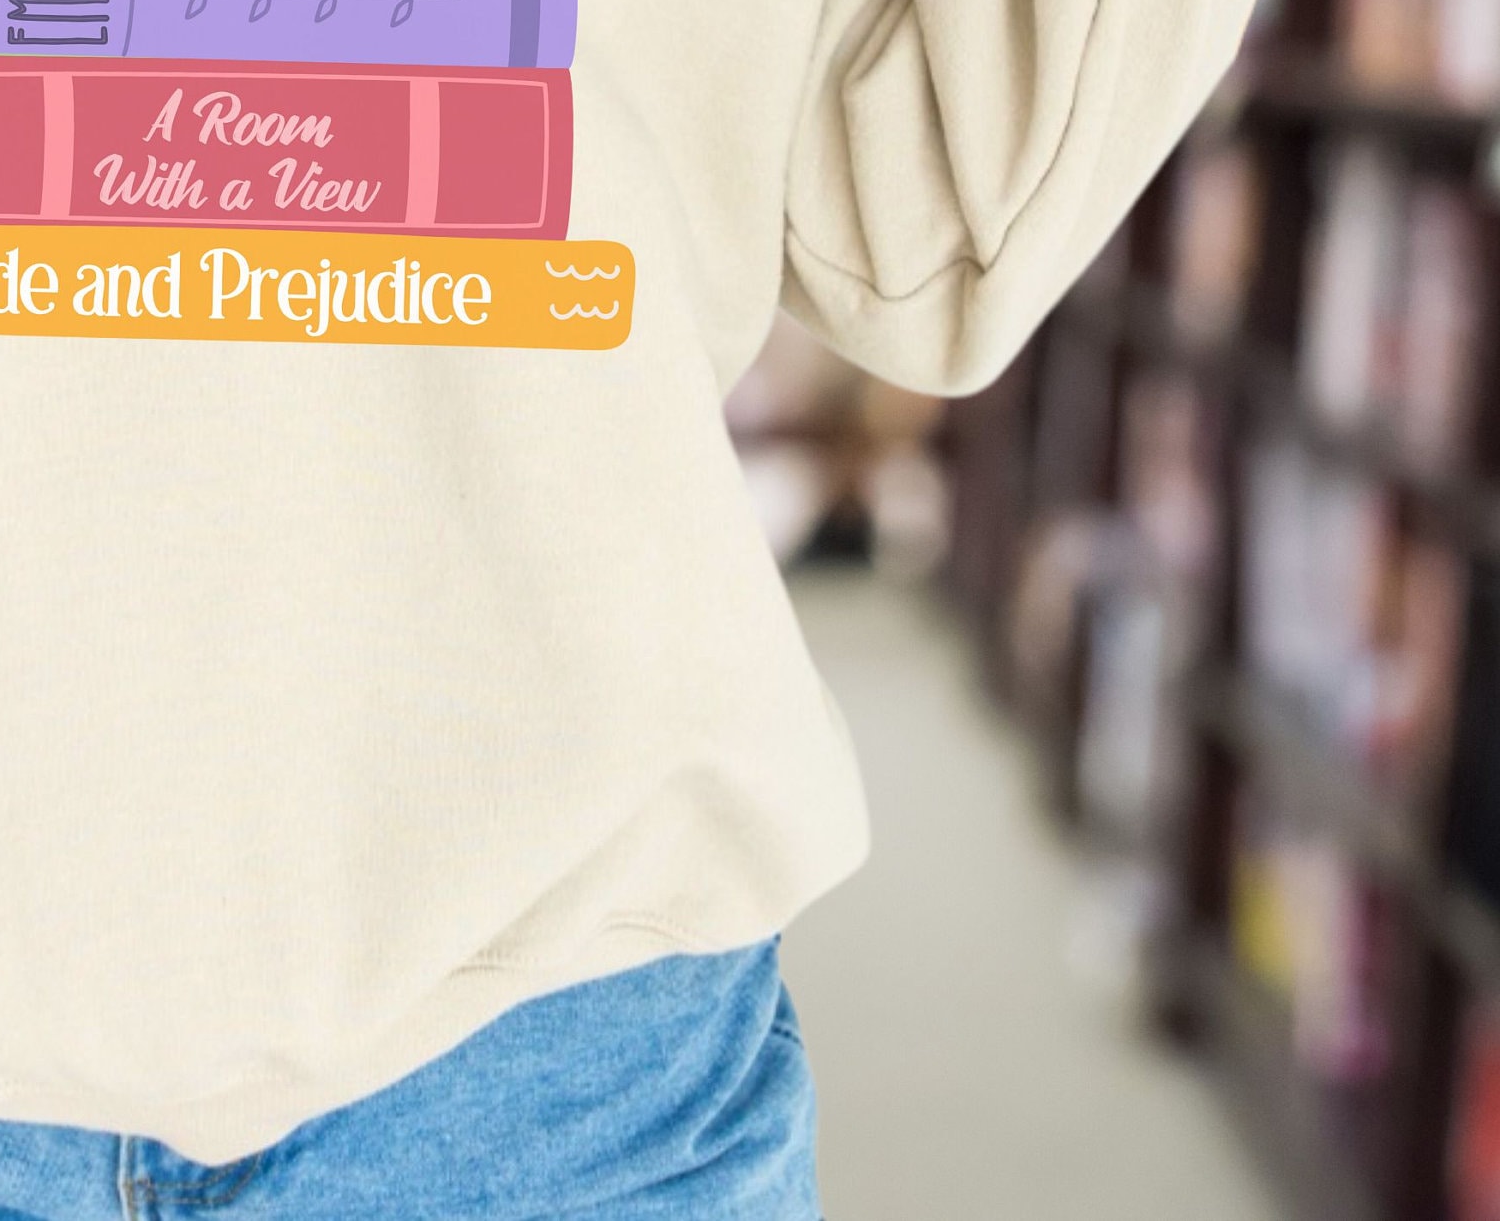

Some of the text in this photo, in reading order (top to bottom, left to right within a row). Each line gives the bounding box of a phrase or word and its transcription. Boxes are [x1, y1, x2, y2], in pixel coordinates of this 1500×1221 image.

[142, 87, 334, 148] A Room
[92, 153, 382, 215] With a View
[72, 251, 183, 321] and
[198, 248, 492, 337] Prejudice
